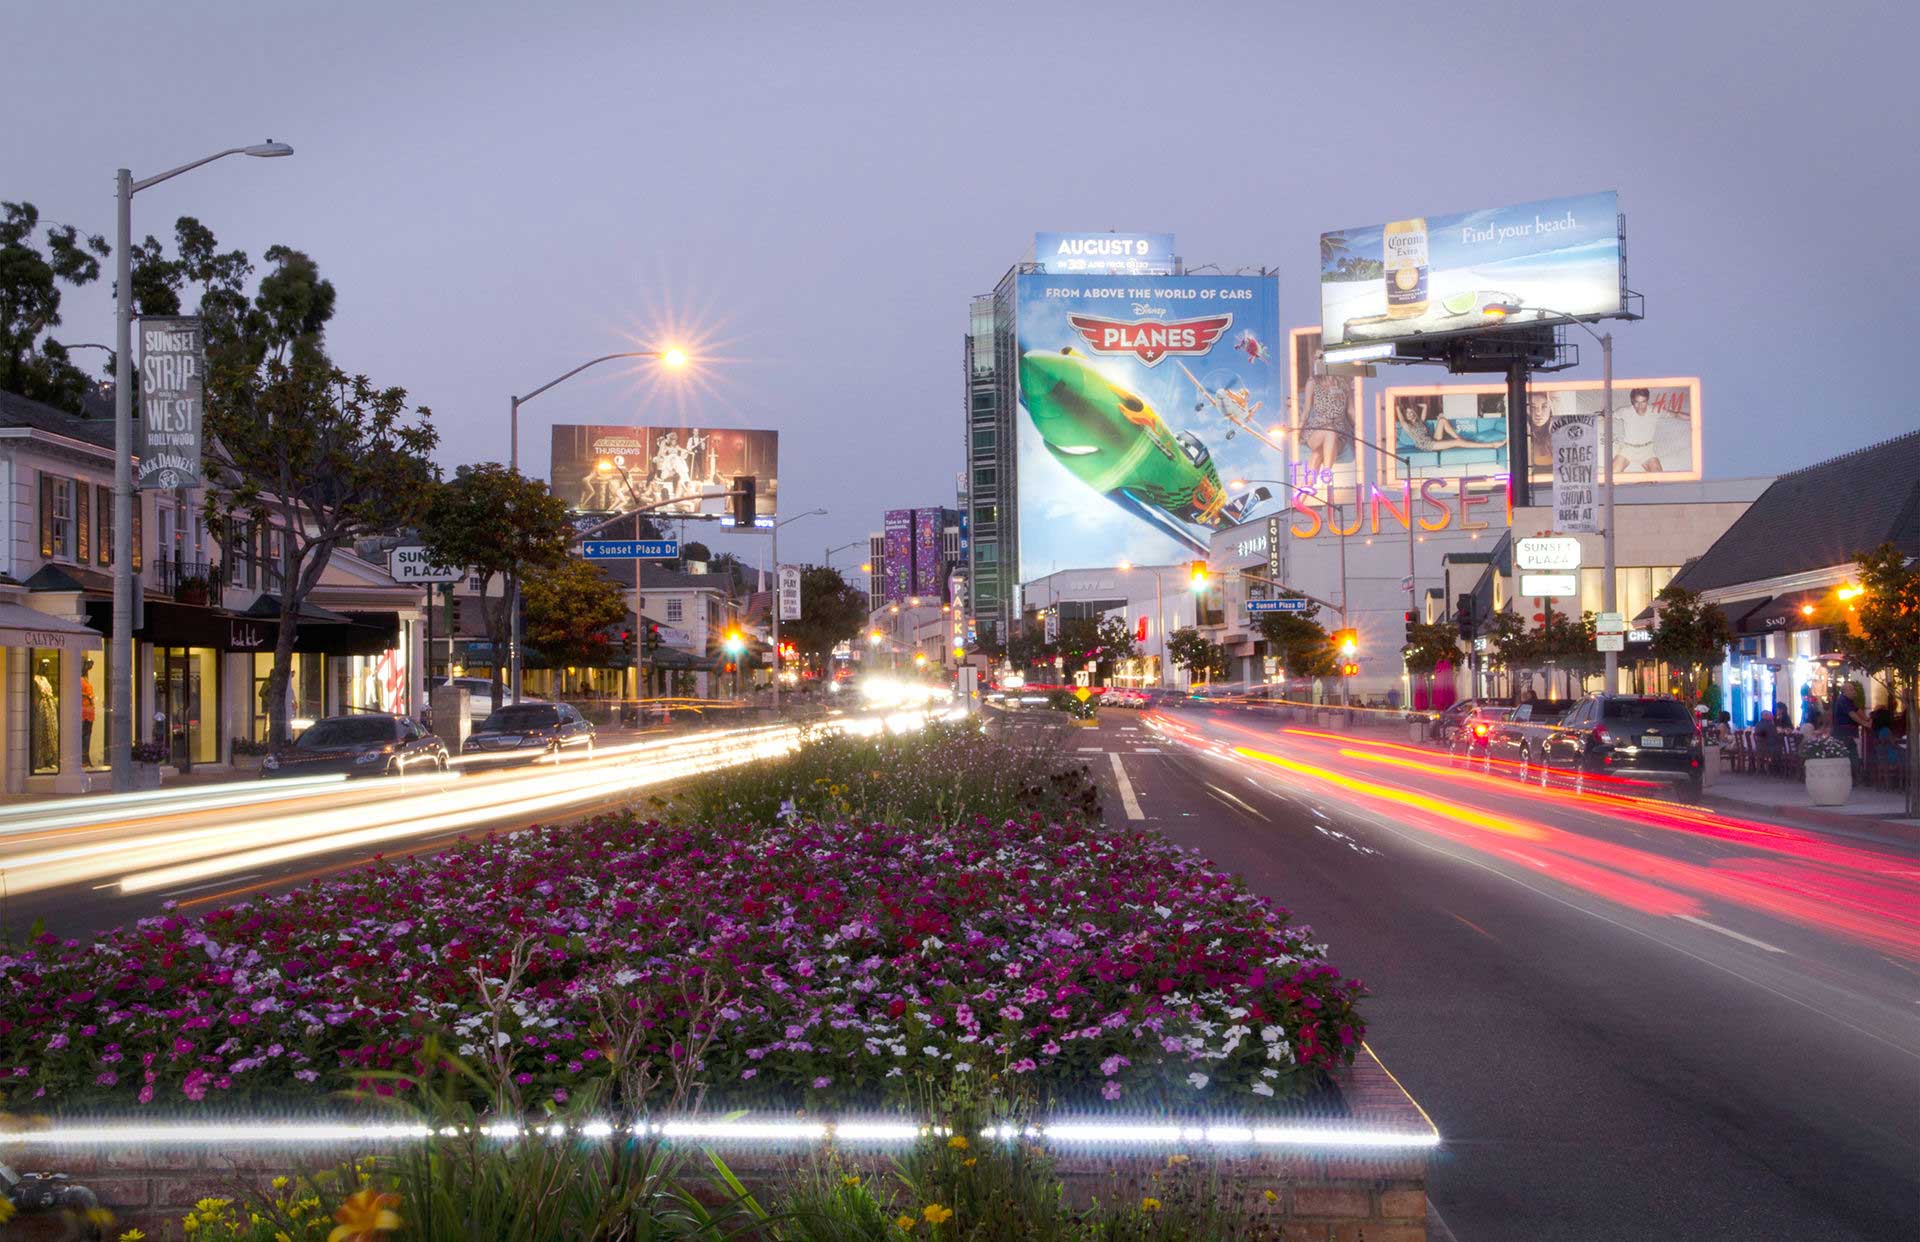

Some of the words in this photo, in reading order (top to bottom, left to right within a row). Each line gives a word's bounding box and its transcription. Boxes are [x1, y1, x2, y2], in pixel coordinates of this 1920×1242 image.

[1461, 221, 1495, 244] Find
[1498, 223, 1532, 245] your
[1535, 210, 1576, 234] beach
[1057, 239, 1133, 255] AUGUST
[1135, 240, 1149, 255] 9
[1046, 288, 1080, 298] FROM
[1084, 288, 1125, 298] ABOVE
[1128, 289, 1150, 299] THE
[1154, 289, 1197, 299] WORLD
[1200, 289, 1217, 299] OF
[1219, 289, 1253, 300] CARS
[1131, 302, 1167, 318] Disney
[145, 331, 194, 352] SUNSET
[1103, 328, 1196, 348] PLANES
[144, 354, 195, 394] STRIP
[147, 399, 194, 432] WEST
[148, 432, 195, 446] HOLLYWOOD
[594, 447, 641, 456] THURSDAYS
[1558, 445, 1592, 464] STAGE
[138, 457, 159, 480] JACK
[1288, 460, 1334, 486] The
[1558, 464, 1592, 483] EVERY
[1560, 490, 1592, 506] SHOULD
[1582, 508, 1592, 520] AT
[599, 545, 632, 555] Sunset
[635, 544, 661, 554] Plaza
[665, 544, 677, 554] Dr
[1270, 519, 1278, 576] EQUINOX
[403, 565, 453, 577] PLAZA
[953, 584, 963, 634] PARK
[1278, 601, 1296, 609] Plaza
[25, 632, 65, 647] CALYPSO
[1628, 631, 1653, 641] CHI
